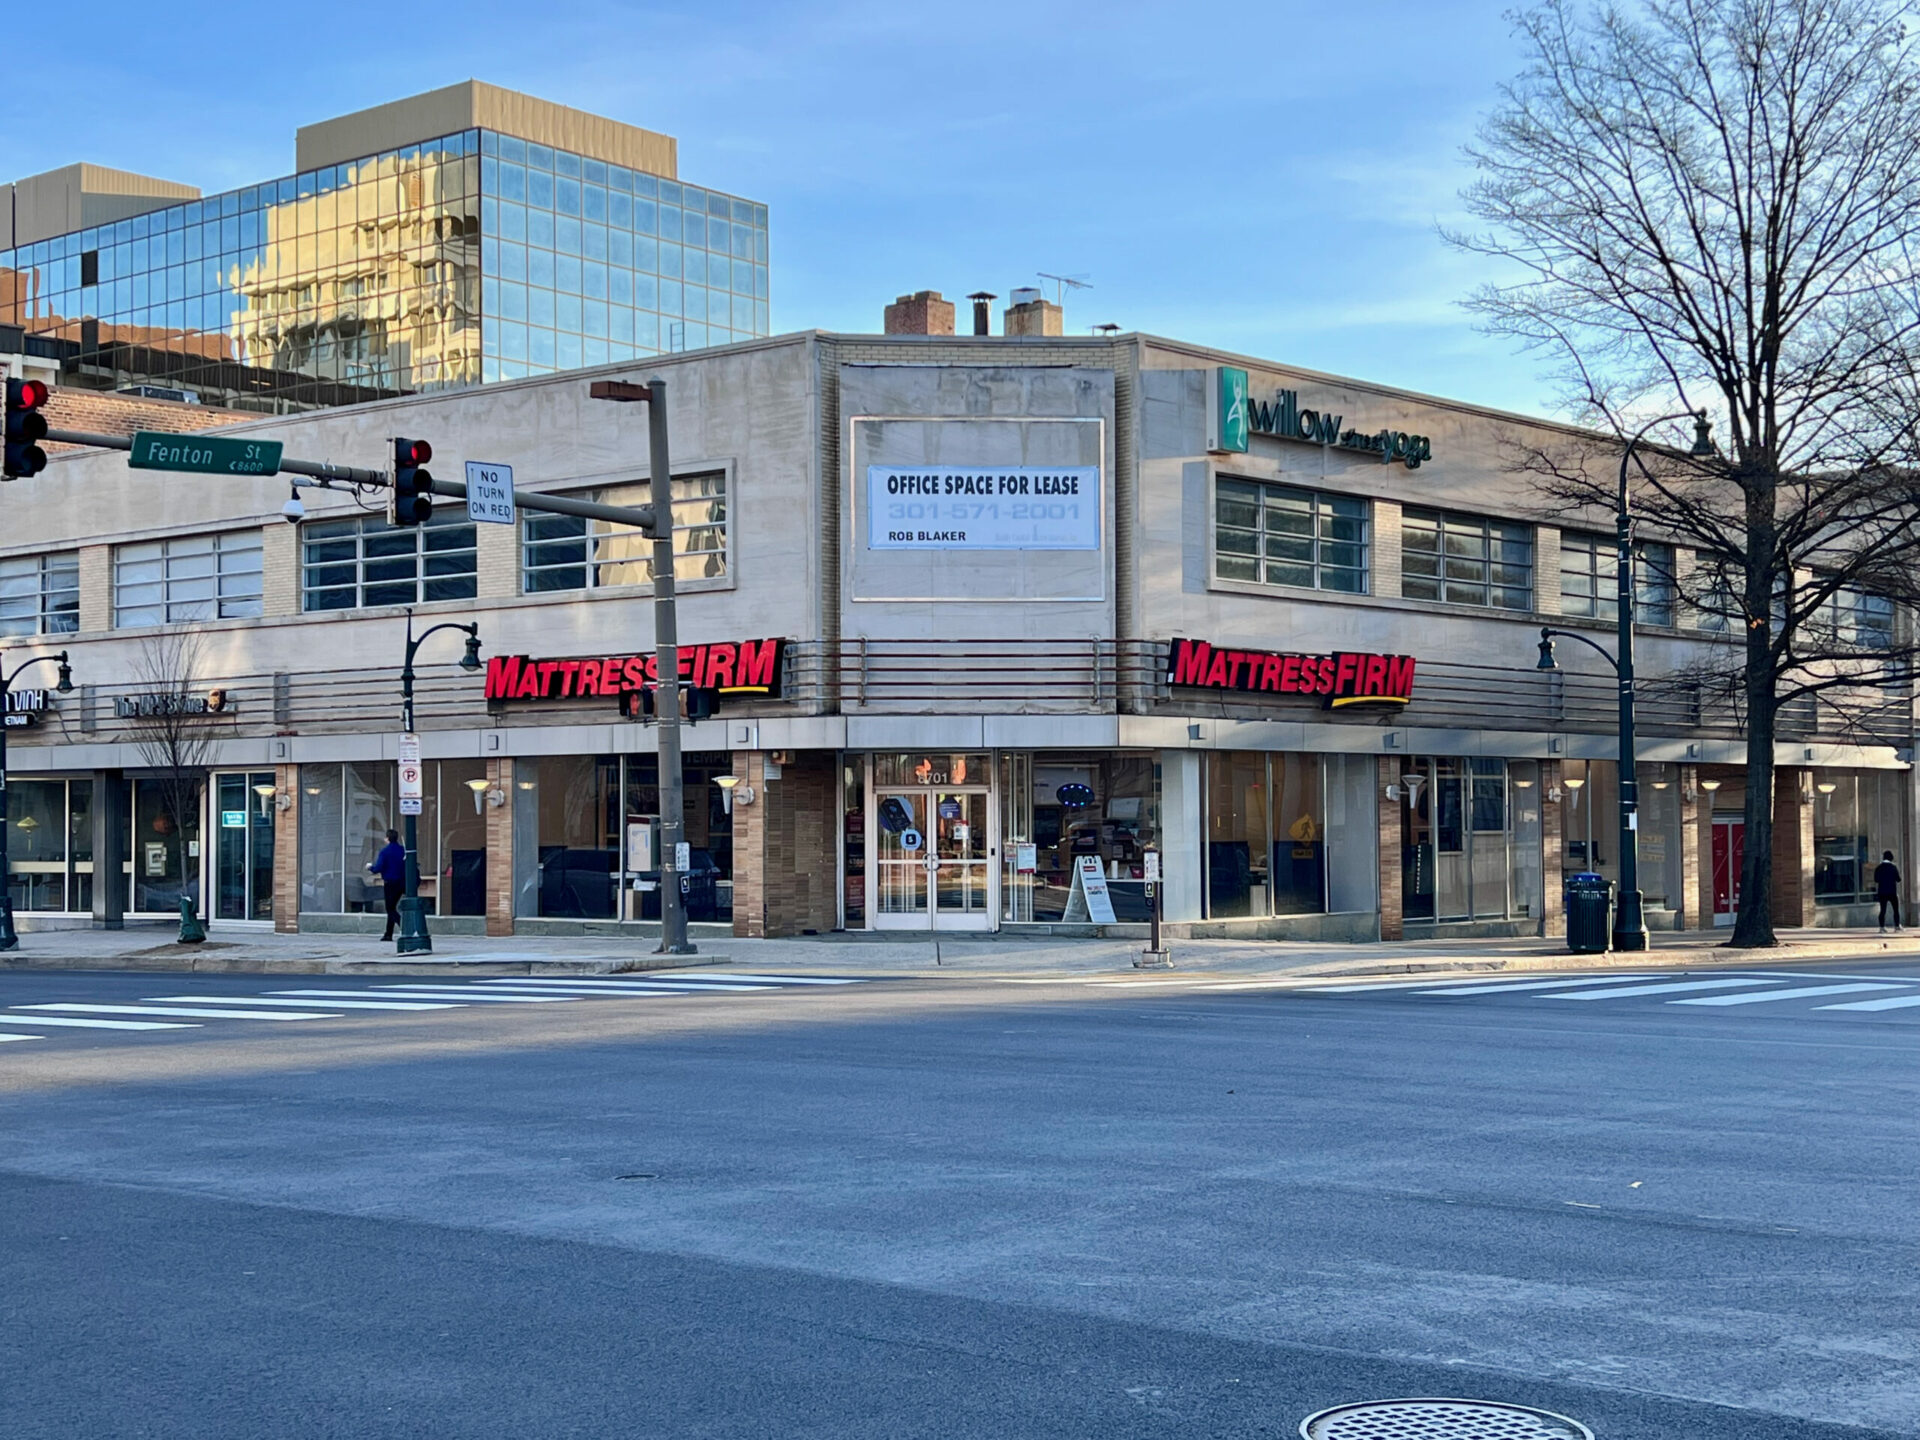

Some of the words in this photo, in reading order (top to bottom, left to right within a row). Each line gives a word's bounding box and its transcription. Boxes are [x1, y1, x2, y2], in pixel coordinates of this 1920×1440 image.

[1250, 388, 1342, 443] willow
[1381, 429, 1432, 470] yoga
[148, 441, 213, 465] Fenton
[245, 444, 261, 460] St
[237, 462, 263, 473] 8600
[481, 470, 498, 483] NO
[477, 486, 505, 500] TURN
[887, 475, 939, 495] OFFICE
[945, 475, 993, 495] SPACE
[999, 475, 1029, 495] FOR
[1034, 475, 1079, 495] LEASE
[472, 501, 486, 514] ON
[491, 503, 510, 517] RED
[888, 503, 1080, 520] 301-571-2001
[888, 531, 914, 541] ROB
[918, 531, 966, 541] BLAKER
[676, 639, 777, 688] FIRM
[1174, 640, 1336, 695] MATTRESS
[1335, 654, 1416, 697] FIRM
[113, 697, 137, 716] The
[139, 694, 166, 716] UPS
[4, 714, 28, 726] ETNAM
[686, 751, 730, 764] TEMPU
[918, 772, 947, 784] 8701
